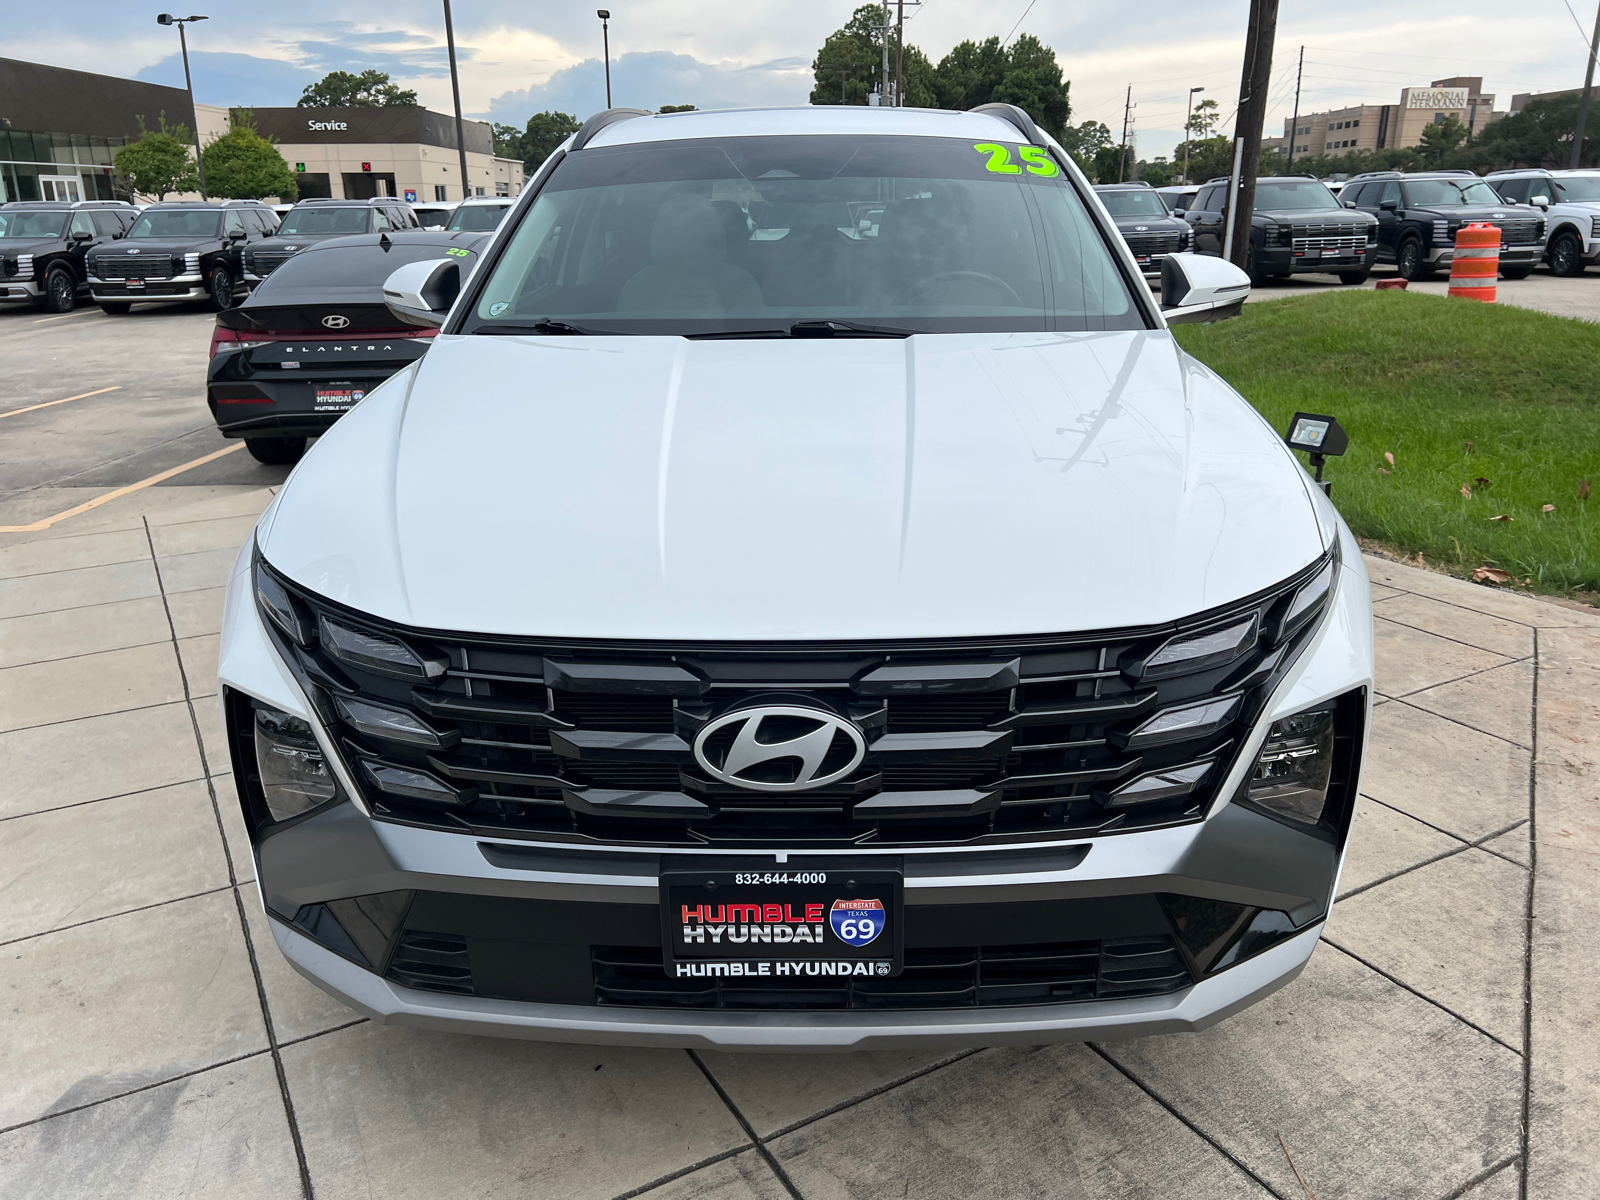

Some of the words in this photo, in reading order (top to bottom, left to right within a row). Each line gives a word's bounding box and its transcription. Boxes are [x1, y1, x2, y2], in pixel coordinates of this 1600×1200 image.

[1411, 92, 1465, 100] MEMORIAL
[1410, 100, 1464, 108] HERMANN
[308, 120, 348, 131] Service
[973, 143, 1060, 178] 25
[446, 247, 470, 258] 25
[286, 345, 392, 353] ELANTRA
[735, 873, 827, 885] 832-644-4000
[839, 901, 876, 909] INTERSTATE
[681, 903, 825, 924] HUMBLE
[683, 925, 824, 944] HYUNDAI
[839, 919, 875, 940] 69
[676, 963, 771, 977] HUMBLE
[775, 962, 873, 976] HYUNDAI
